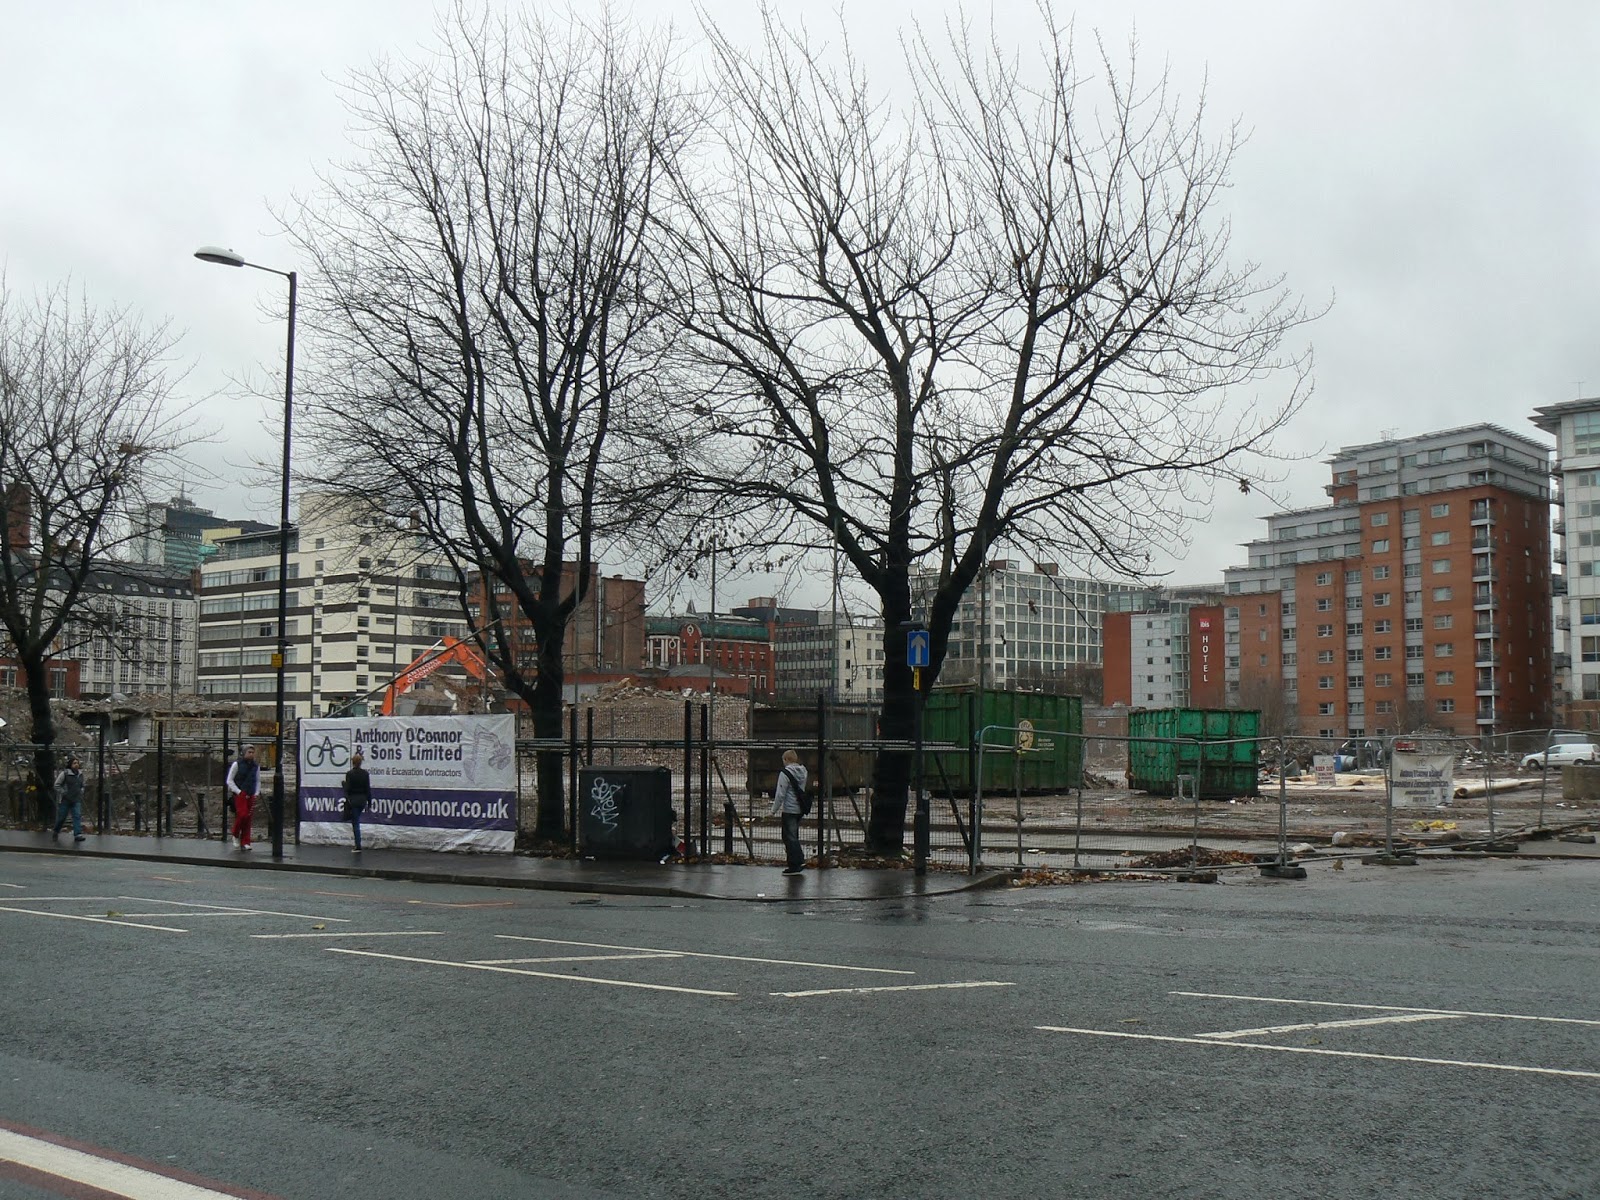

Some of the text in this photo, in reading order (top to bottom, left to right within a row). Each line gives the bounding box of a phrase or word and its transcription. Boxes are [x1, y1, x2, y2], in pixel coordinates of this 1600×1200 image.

[355, 727, 462, 746] Anthony O'Connor
[370, 744, 402, 760] Sons
[409, 745, 462, 761] Limited
[392, 767, 423, 776] Excavation
[424, 768, 462, 777] Contractors
[304, 797, 509, 819] www.aonyoconnor.co.uk
